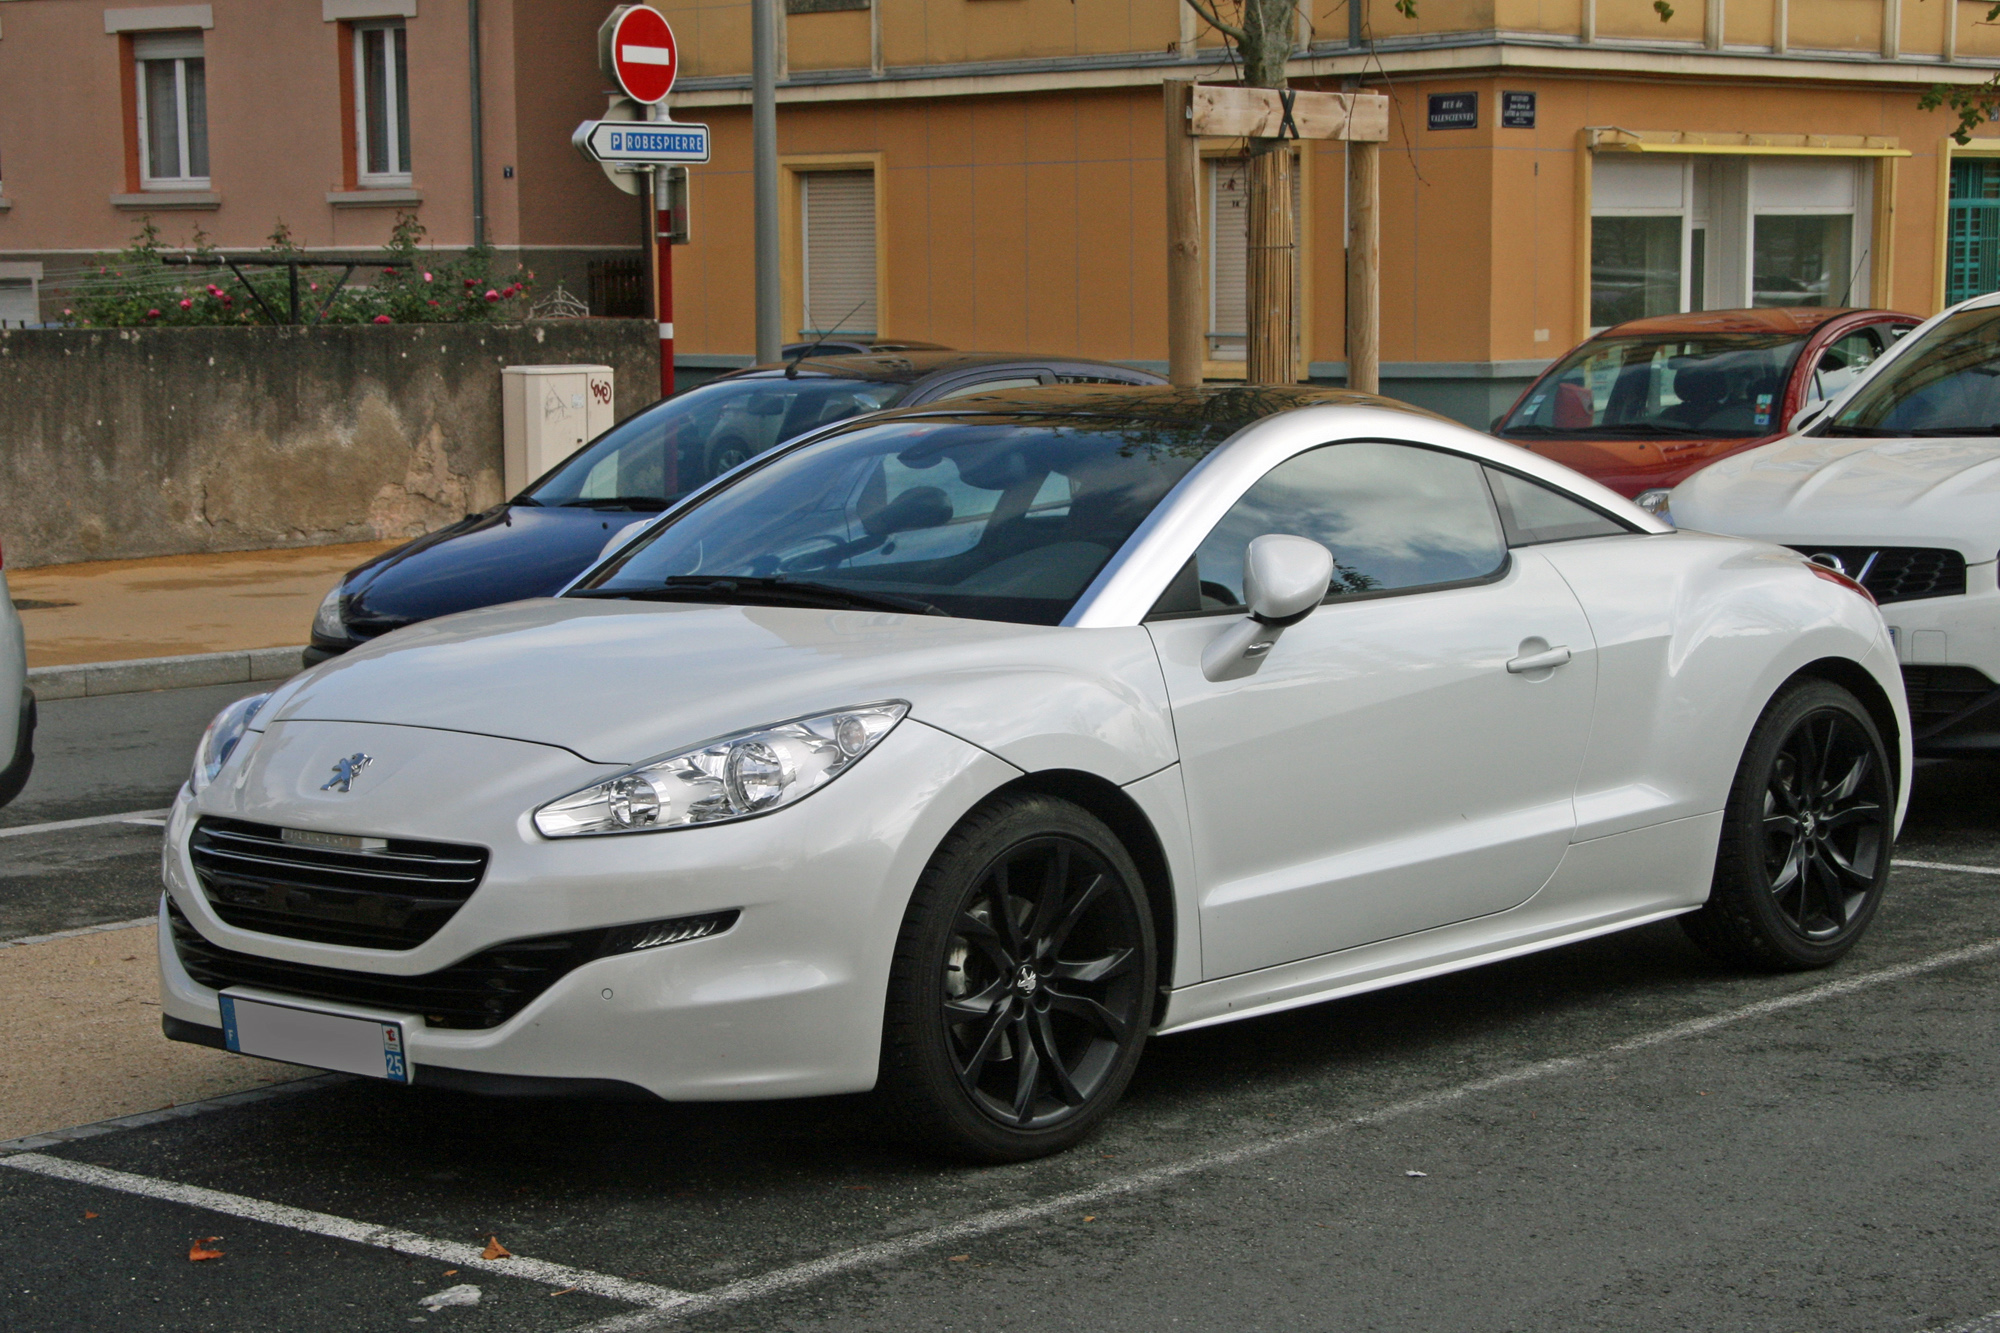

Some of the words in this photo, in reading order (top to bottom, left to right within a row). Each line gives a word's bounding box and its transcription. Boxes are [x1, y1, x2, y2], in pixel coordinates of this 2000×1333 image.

[612, 134, 620, 149] P
[627, 135, 703, 151] ROBESPIERRE
[228, 1030, 234, 1040] F
[386, 1054, 403, 1076] 25
